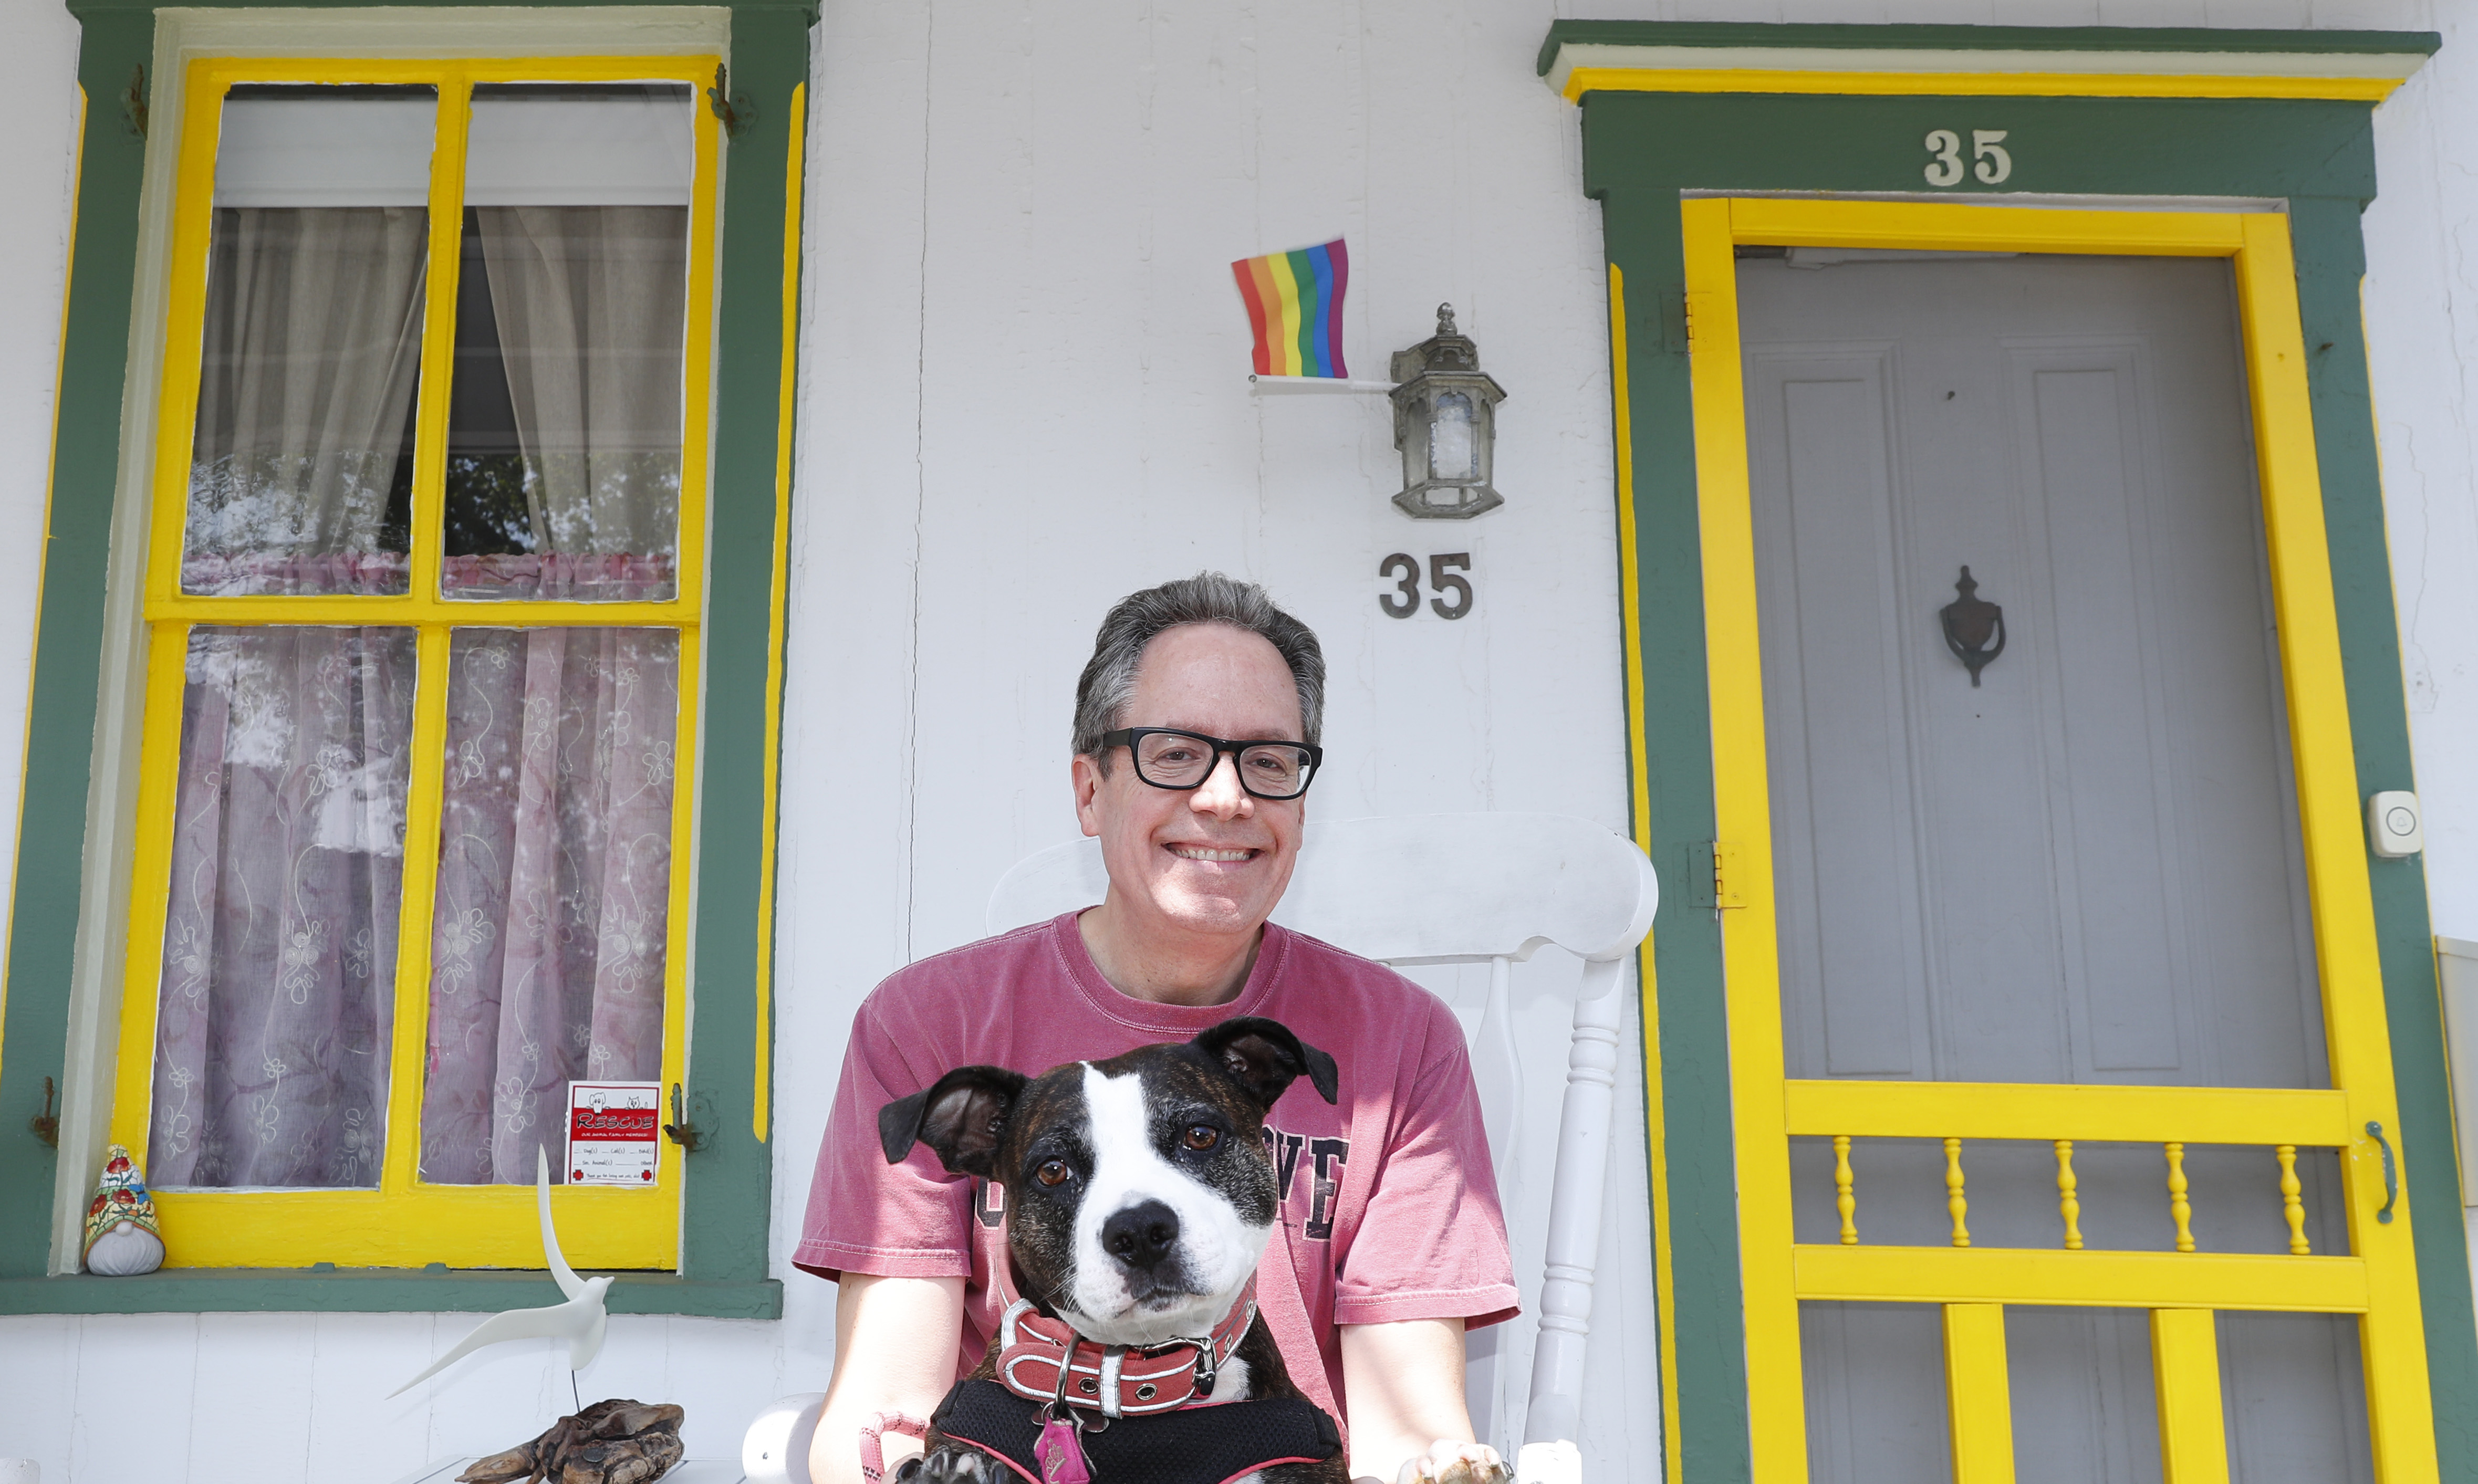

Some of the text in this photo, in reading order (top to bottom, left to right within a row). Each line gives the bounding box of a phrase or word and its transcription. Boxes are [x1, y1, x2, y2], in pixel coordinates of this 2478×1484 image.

[1924, 129, 2012, 186] 35
[1380, 552, 1473, 620] 35
[577, 1113, 654, 1129] RESCUE
